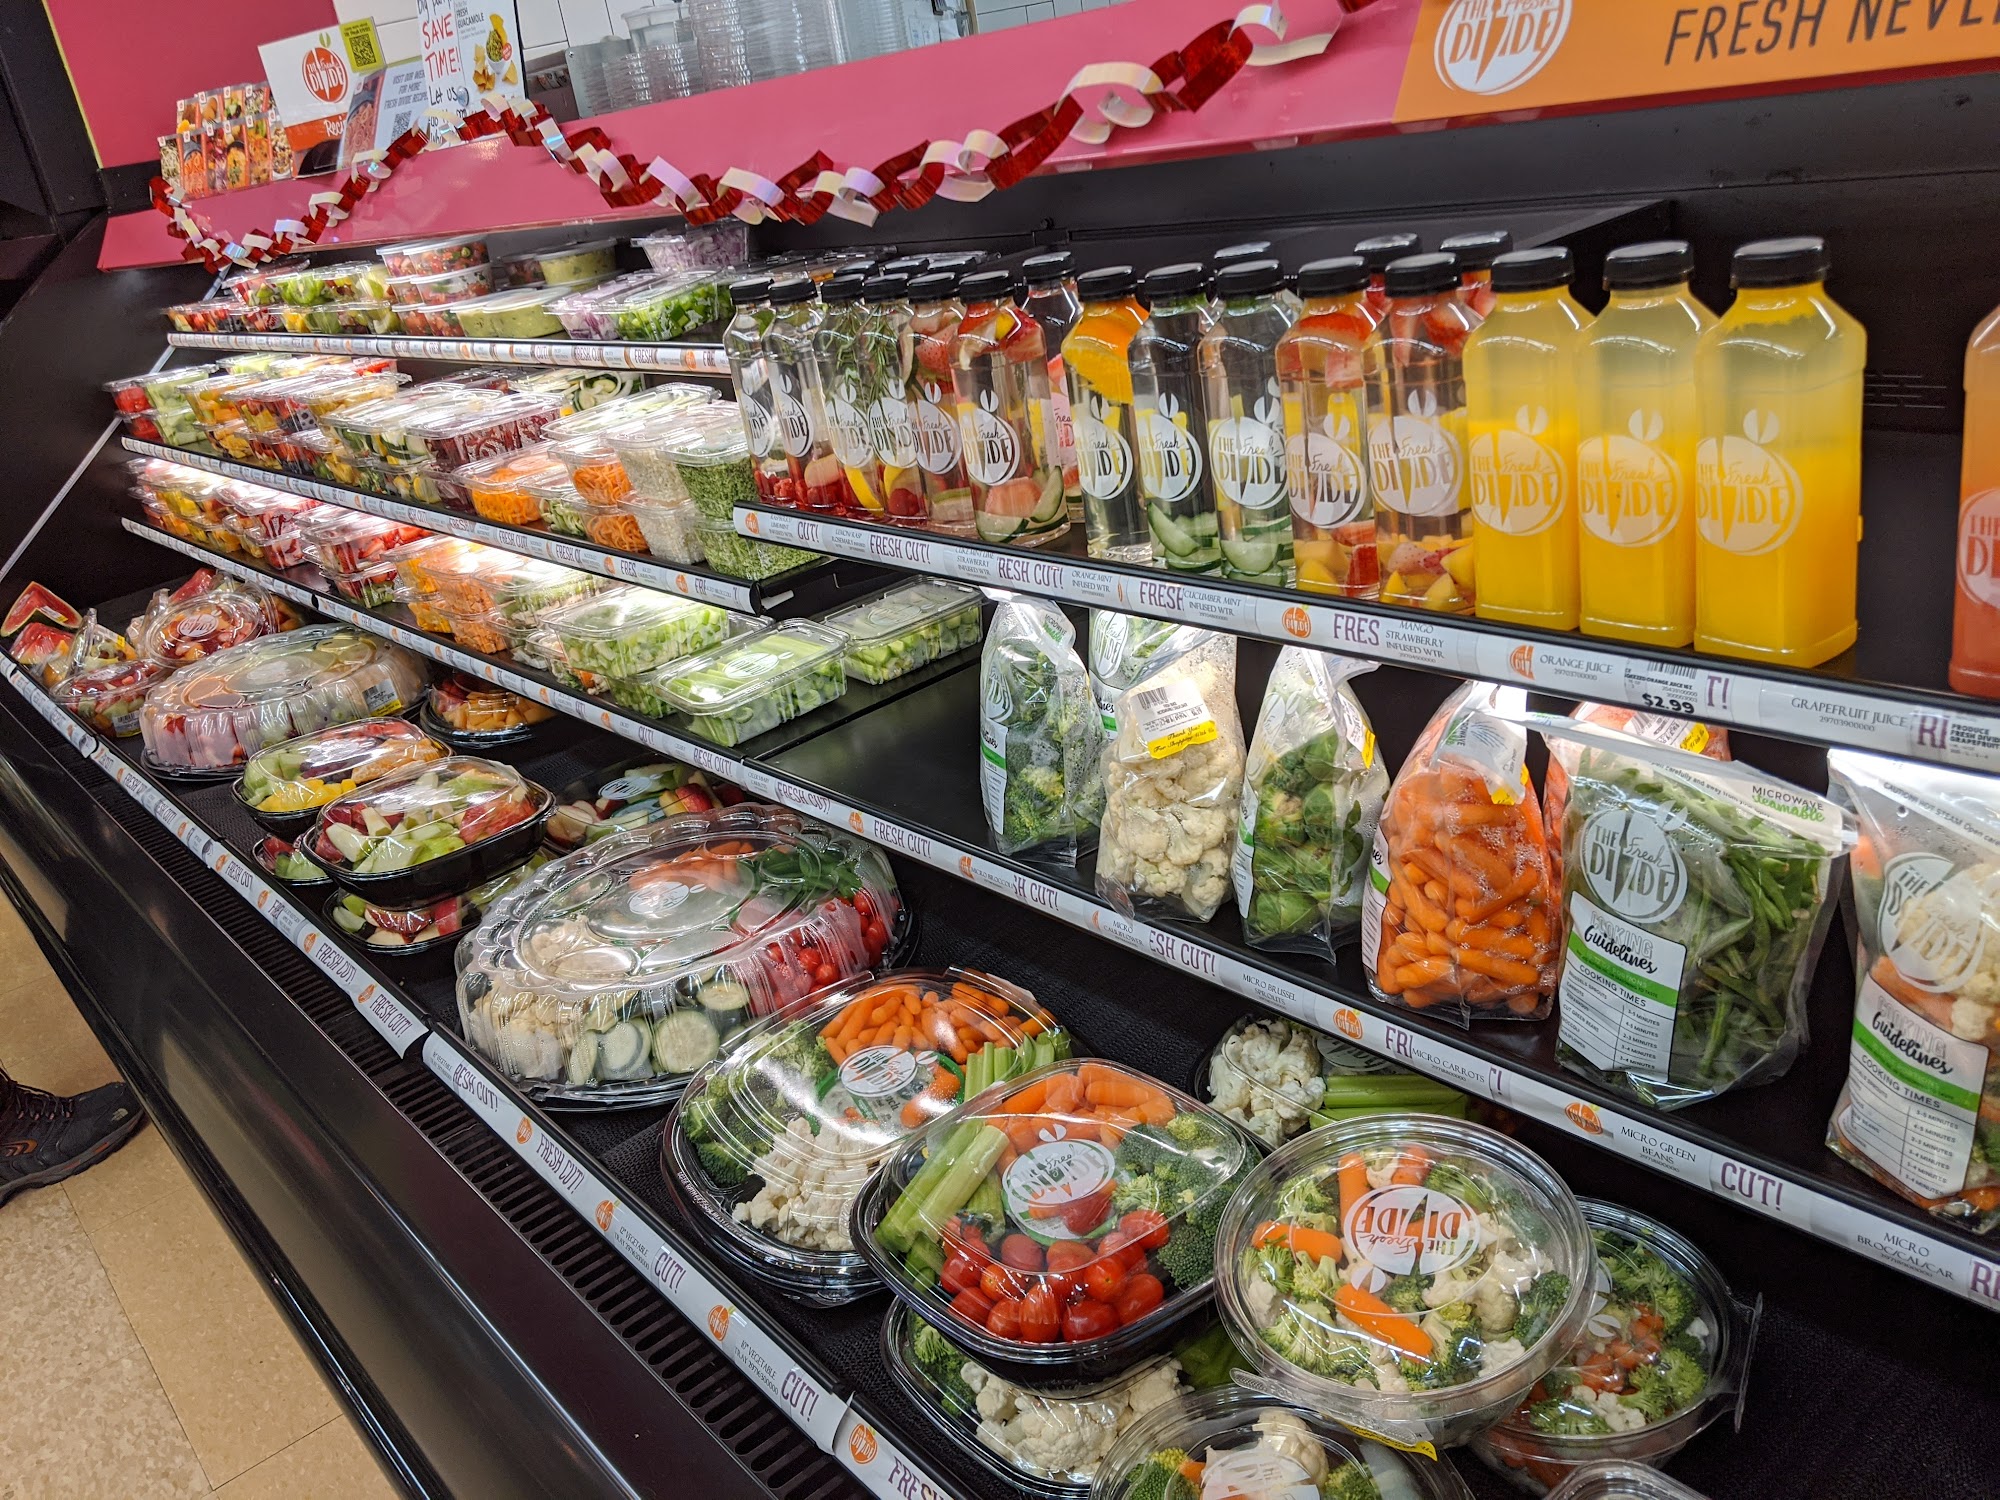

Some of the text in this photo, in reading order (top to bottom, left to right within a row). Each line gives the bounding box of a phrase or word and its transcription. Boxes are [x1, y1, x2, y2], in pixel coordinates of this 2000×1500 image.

[422, 13, 454, 49] SAVE
[1664, 0, 1828, 66] FRESH
[1449, 9, 1559, 82] DIVIDE
[425, 45, 461, 82] TIME!
[308, 67, 346, 96] DIVIDE
[428, 86, 443, 106] Let
[1153, 432, 1189, 451] Fresh
[1217, 435, 1235, 454] THE
[1370, 441, 1391, 461] THE
[1399, 431, 1446, 456] Fresh
[1218, 451, 1286, 499] DIVIDE
[1471, 455, 1494, 476] THE
[1499, 449, 1553, 474] Fresh
[1580, 460, 1604, 482] THE
[1611, 456, 1668, 483] Fresh
[1723, 460, 1782, 487] Fresh
[1289, 466, 1357, 519] DIVIDE
[1372, 453, 1455, 512] DIVIDE
[1473, 472, 1555, 523] DIVIDE
[1580, 477, 1673, 535] DIVIDE
[1697, 480, 1789, 543] DIVIDE
[797, 520, 820, 544] CUT!
[870, 533, 932, 566] FRESH CUT!
[1033, 563, 1064, 591] CUT!
[1072, 570, 1113, 584] ORANGE MINT
[1072, 579, 1111, 593] INFUSED WTR
[1184, 589, 1242, 607] CUCUMBER MINT
[1189, 601, 1235, 617] INFUSED WTR
[1332, 612, 1381, 647] FRES
[1385, 629, 1446, 649] STRAWBERRY
[1399, 620, 1435, 635] MANGO
[1386, 641, 1445, 661] INFUSED WTR
[1538, 653, 1614, 675] ORANGE JUICE
[1641, 692, 1695, 714] $2.99
[1790, 697, 1909, 728] GRAPEFRUIT JUICE
[1818, 715, 1876, 732] 29703900000
[1950, 730, 1977, 740] FRESH
[1951, 724, 1990, 736] PRODUCE
[714, 755, 733, 779] CUT!
[1665, 766, 1694, 784] carefully
[1692, 780, 1706, 788] and
[1706, 786, 1723, 796] away
[777, 781, 808, 806] FRESH
[807, 792, 831, 816] CUT!
[1751, 784, 1824, 811] MICROWAVE
[873, 819, 932, 860] FRESH CUT!
[1595, 824, 1620, 849] THE
[1962, 821, 1984, 840] Open
[1623, 836, 1671, 869] Fresh
[225, 859, 243, 883] FRESH
[1589, 840, 1676, 904] DIVIDE
[1898, 863, 1931, 898] THE
[1030, 881, 1060, 912] CUT!
[1112, 919, 1134, 934] MICRO
[1180, 942, 1217, 977] CUT!
[1584, 924, 1658, 975] Guidelines
[315, 942, 357, 985] FRESH CUT!
[1241, 973, 1298, 1002] MICRO BRUSSEL
[1253, 987, 1287, 1006] SPROUTS
[1579, 964, 1647, 1008] COOKING TIMES
[369, 993, 413, 1039] FRESH CUT!
[1562, 1003, 1601, 1034] CUT GREEN BEANS
[1635, 1013, 1661, 1028] MINUTES
[1631, 1036, 1659, 1050] MINUTES
[1633, 1024, 1660, 1039] MINUTES
[1872, 1010, 1954, 1076] Guidelines
[1411, 1047, 1442, 1065] MICRO
[1441, 1059, 1486, 1083] CARROTS
[1628, 1058, 1656, 1071] MINUTES
[1630, 1047, 1657, 1061] MINUTES
[1861, 1053, 1942, 1110] COOKING TIMES
[476, 1080, 499, 1113] CUT!
[1925, 1127, 1957, 1144] MINUTES
[1927, 1113, 1959, 1131] MINUTES
[1620, 1126, 1698, 1162] MICRO GREEN
[1641, 1146, 1675, 1168] BEANS
[1922, 1140, 1954, 1158] MINUTES
[536, 1133, 585, 1195] FRESH CUT!
[1919, 1153, 1951, 1171] MINUTES
[1720, 1160, 1784, 1212] CUT!
[1355, 1193, 1463, 1242] DIVIDE
[624, 1230, 649, 1259] VEGETABLE
[1359, 1231, 1419, 1257] Fresh
[1883, 1231, 1930, 1258] MICRO
[653, 1250, 688, 1294] CUT!
[734, 1346, 749, 1367] TRAY
[748, 1345, 777, 1381] VEGETABLE
[780, 1369, 820, 1423] CUT!
